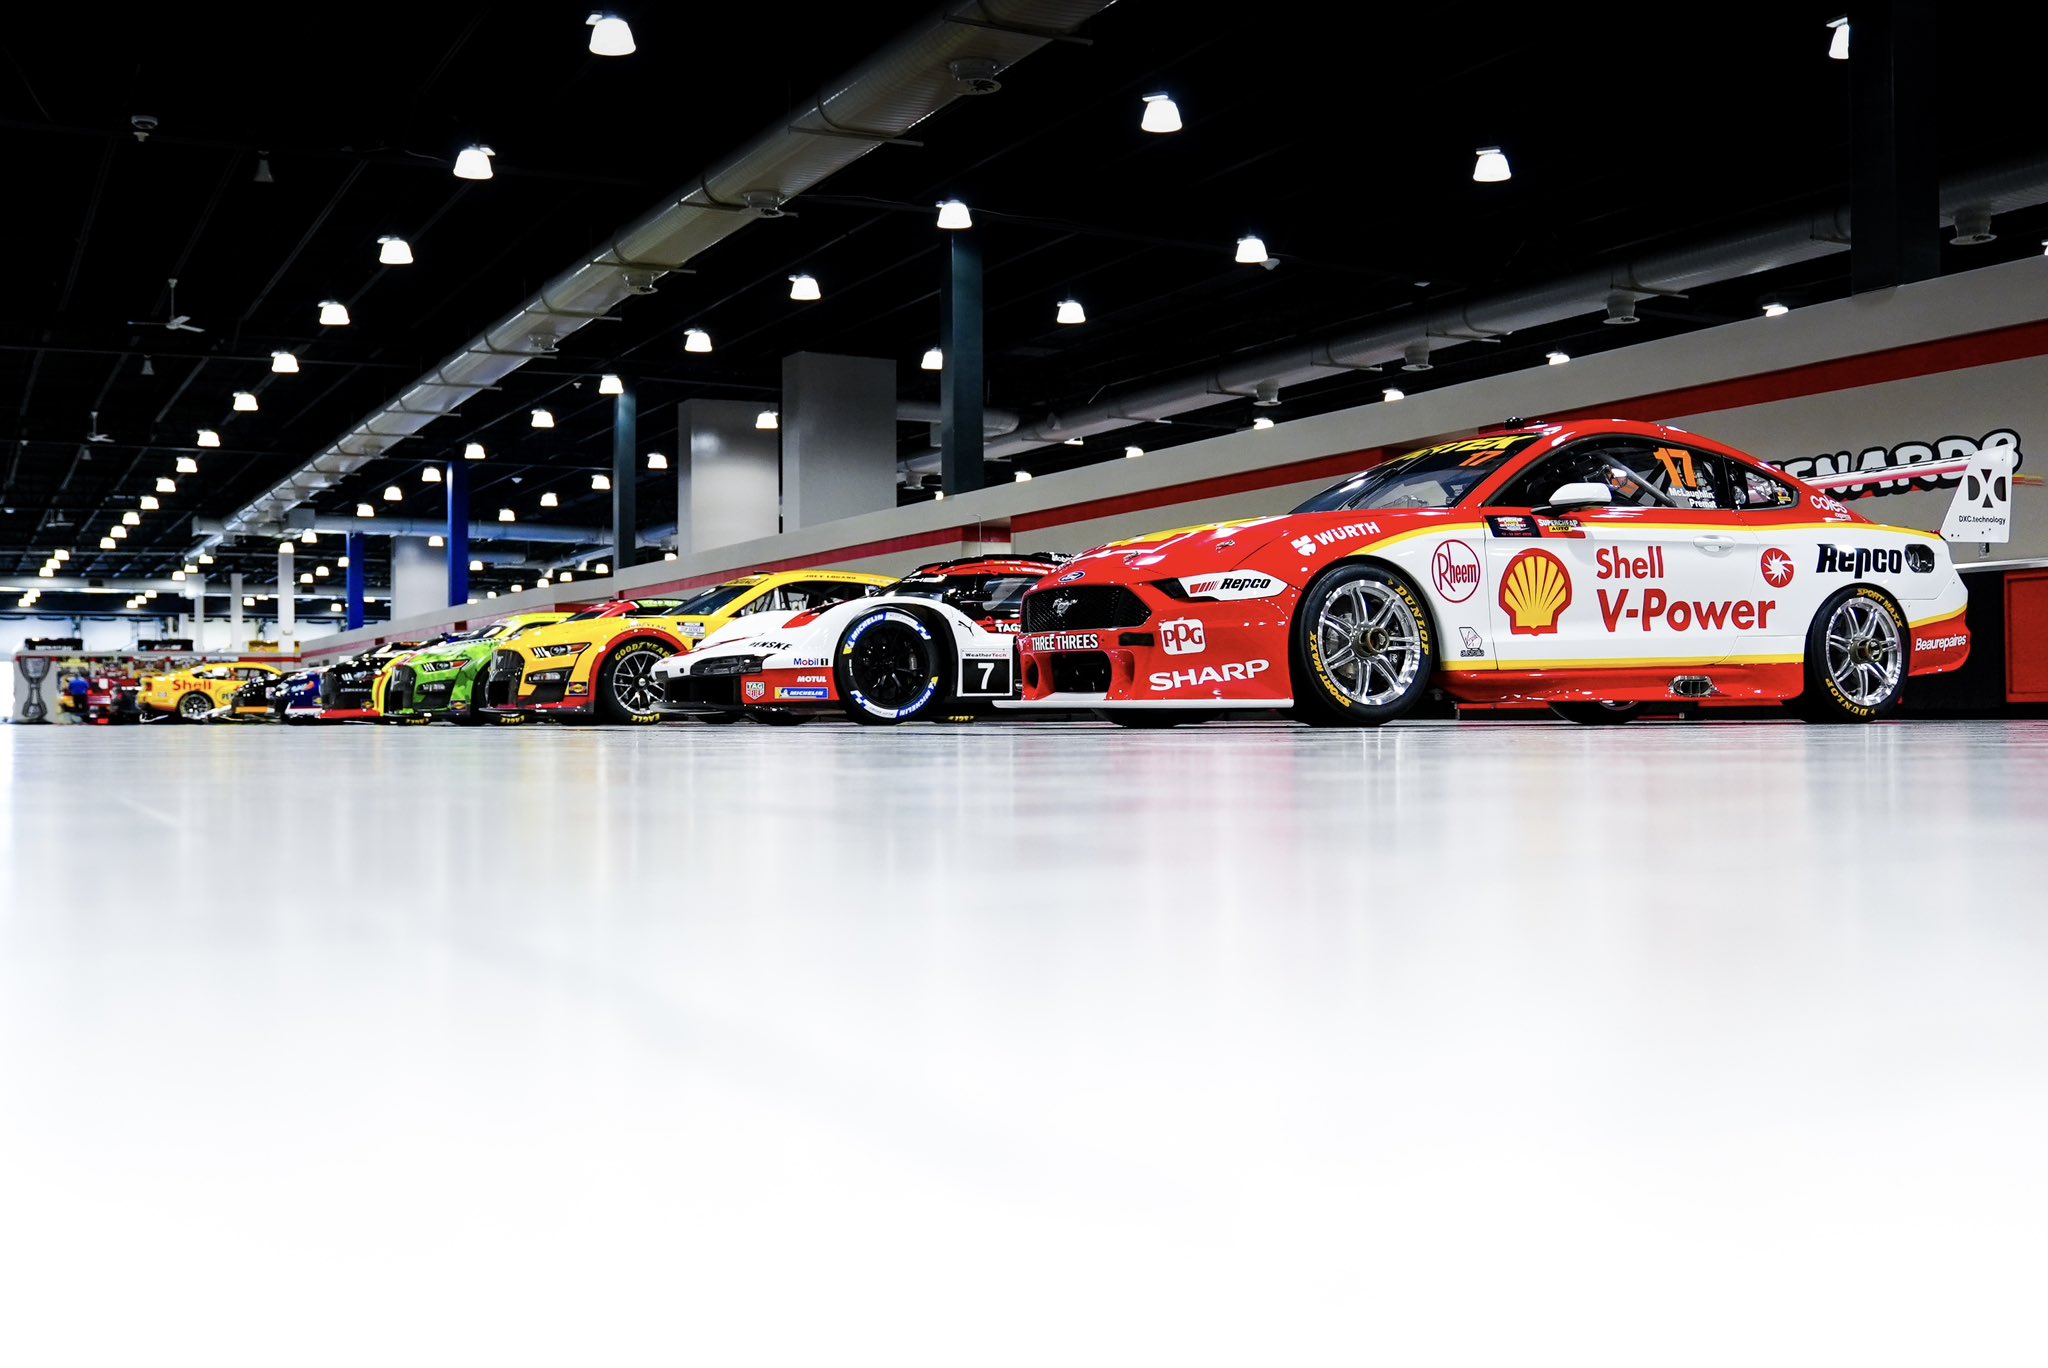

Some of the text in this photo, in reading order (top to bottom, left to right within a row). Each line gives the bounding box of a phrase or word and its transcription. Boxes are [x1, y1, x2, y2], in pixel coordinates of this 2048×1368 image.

[1459, 450, 1506, 467] 17
[1653, 447, 1697, 488] 17
[1668, 487, 1715, 499] McLaughlin
[1810, 495, 1848, 513] coles
[1538, 518, 1579, 527] SUPERCHEAP
[1958, 515, 2007, 525] DXC.technology
[1437, 542, 1477, 592] Rheem
[1596, 545, 1664, 580] Shell
[1815, 543, 1902, 579] Repco
[1219, 577, 1271, 592] Repco
[1394, 585, 1431, 656] DUNLOP
[1596, 588, 1776, 633] V-Power
[1856, 588, 1904, 629] SPORT MAXX
[851, 613, 884, 641] MICHELIN
[1032, 633, 1099, 651] THREE THREES
[1915, 633, 1967, 652] Beaurepaires
[793, 657, 829, 667] Mobil 1
[977, 662, 995, 690] 7
[1149, 659, 1271, 692] SHARP
[1309, 630, 1353, 708] SPORT MAXX
[172, 679, 212, 692] Shell
[796, 675, 828, 683] MOTUL
[899, 688, 932, 717] MICHELIN
[1825, 678, 1869, 717] DUNLOP
[631, 713, 661, 723] EAGLE
